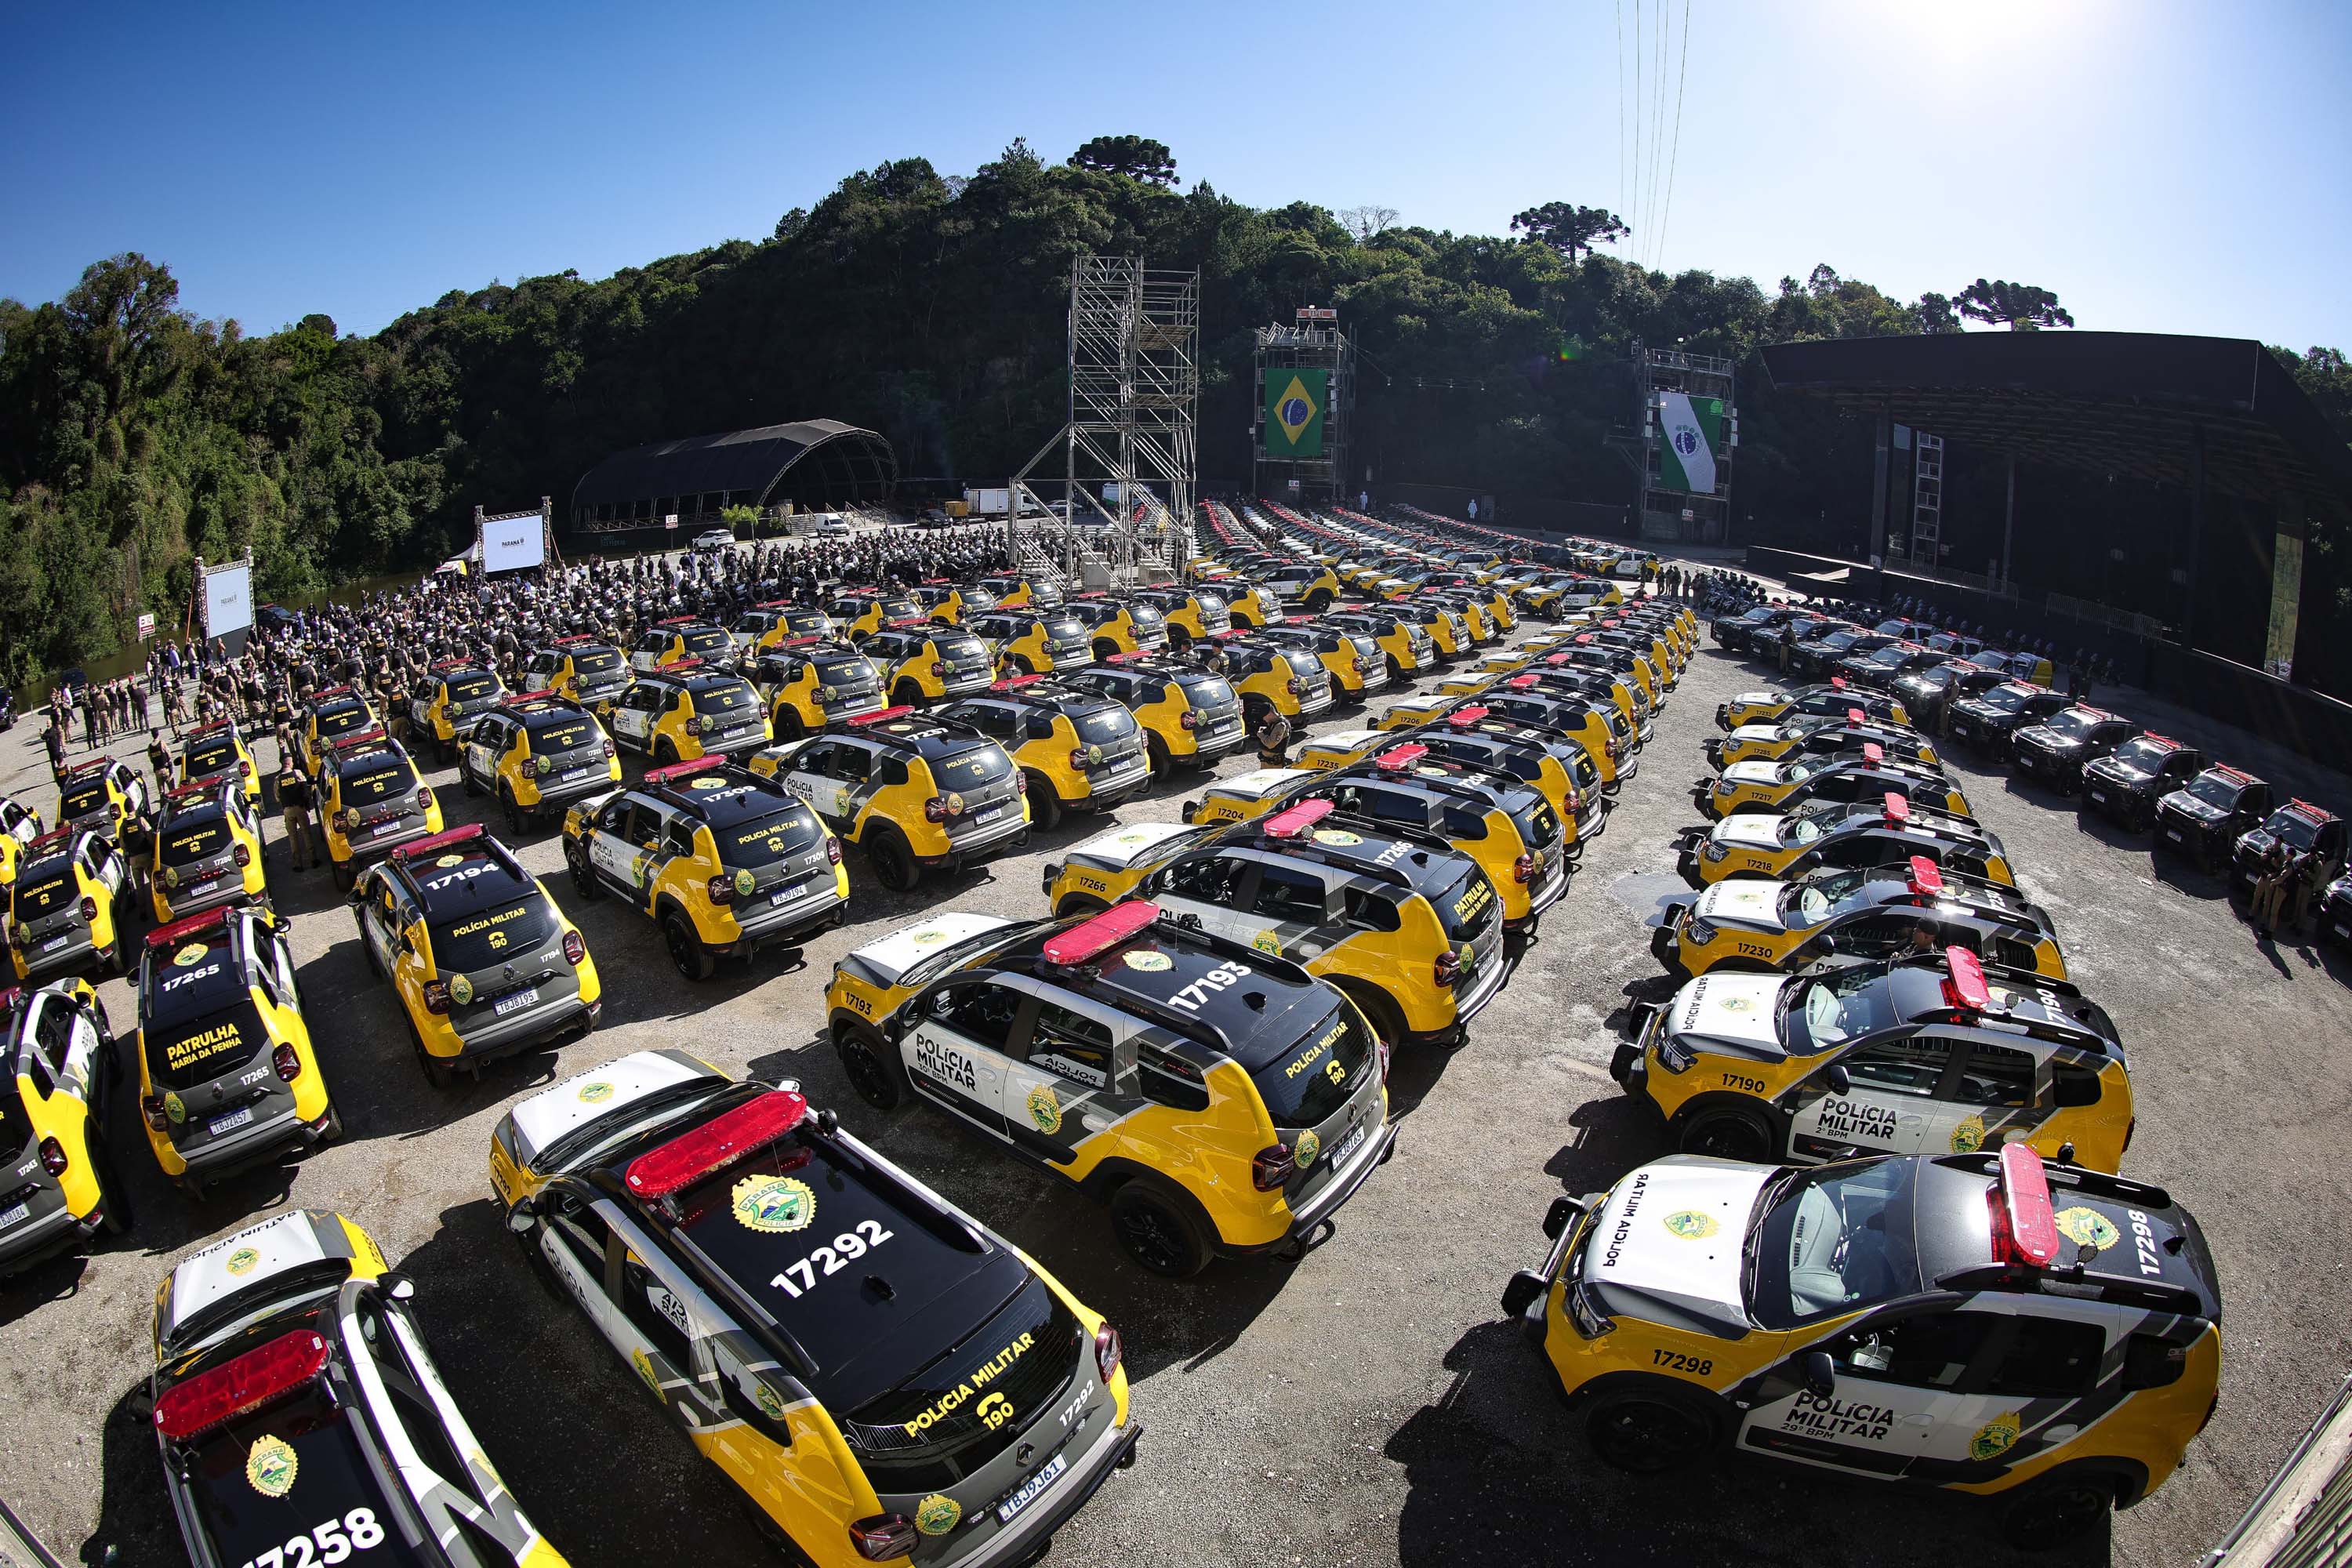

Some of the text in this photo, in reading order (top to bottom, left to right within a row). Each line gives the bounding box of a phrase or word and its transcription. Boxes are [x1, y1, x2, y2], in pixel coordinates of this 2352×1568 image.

[1316, 759, 1339, 769] 17235
[787, 778, 812, 793] POLÍCIA
[1751, 792, 1772, 801] 17217
[1218, 808, 1244, 821] 17204
[739, 820, 799, 845] POLÍCIA MILITAR
[769, 842, 784, 852] 190
[804, 851, 824, 866] 17309
[426, 862, 499, 891] 17194
[1747, 858, 1772, 871] 17218
[1079, 877, 1106, 892] 17266
[1454, 880, 1488, 916] PATRULHA
[452, 907, 527, 938] POLÍCIA MILITAR
[489, 937, 508, 949] 190
[540, 949, 561, 964] 17194
[1737, 942, 1773, 959] 17230
[163, 964, 220, 991] 17265
[1168, 960, 1252, 1011] 17193
[845, 991, 873, 1016] 17193
[2036, 987, 2068, 1024] 7190
[166, 1022, 239, 1062] PATRULHA
[171, 1036, 242, 1071] MARIA DA PENHA
[916, 1033, 975, 1077] POLÍCIA
[1286, 1022, 1348, 1080] POLÍCIA MILITAR
[241, 1065, 270, 1087] 17265
[916, 1051, 977, 1092] MILITAR
[932, 1070, 949, 1086] BPM
[1329, 1067, 1346, 1086] 190
[1722, 1073, 1766, 1094] 17190
[1818, 1112, 1895, 1140] MILITAR
[1823, 1098, 1897, 1127] POLÍCIA
[1827, 1129, 1849, 1140] BPM
[17, 1159, 39, 1177] 17243
[0, 1207, 26, 1228] BJ8I84
[2128, 1208, 2161, 1276] 17298
[770, 1220, 895, 1298] 17292
[1653, 1348, 1713, 1376] 17298
[904, 1332, 1036, 1438] POLÍCIA MILITAR
[982, 1402, 1014, 1432] 190
[1058, 1380, 1095, 1427] 17292
[1793, 1392, 1894, 1426] POLÍCIA
[1785, 1409, 1889, 1441] MILITAR
[1806, 1427, 1836, 1440] BPM
[1006, 1461, 1061, 1515] TBJ9J61
[241, 1505, 386, 1568] 7258
